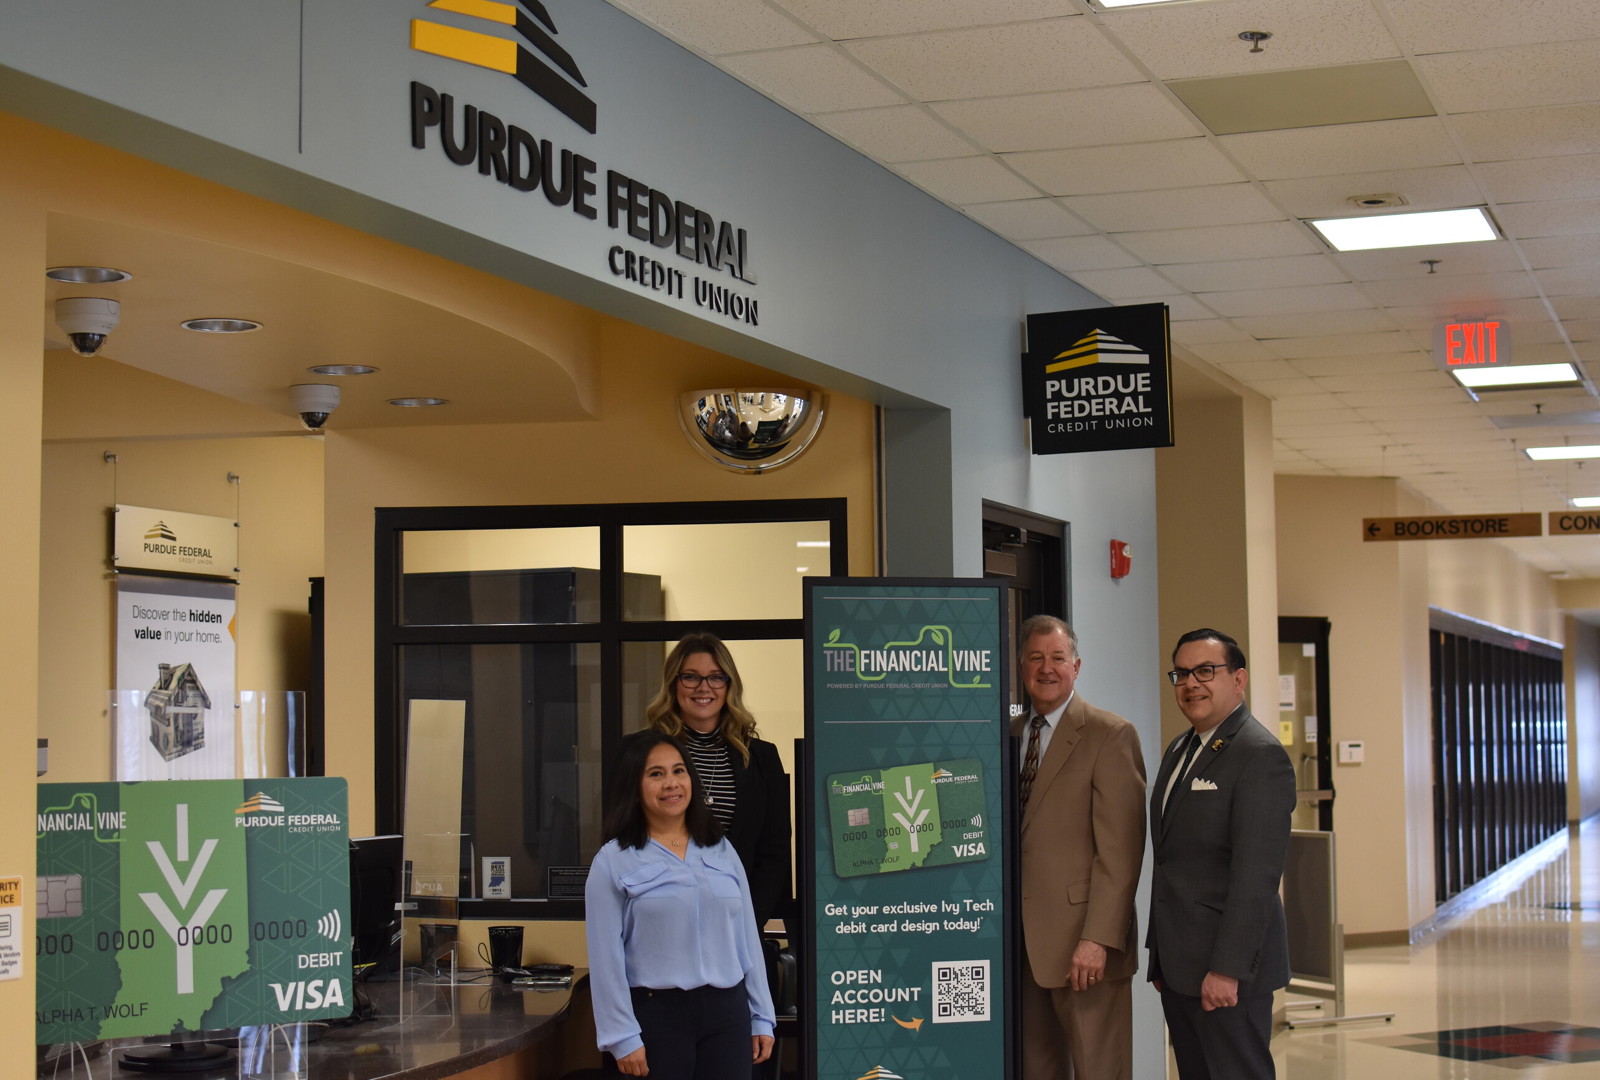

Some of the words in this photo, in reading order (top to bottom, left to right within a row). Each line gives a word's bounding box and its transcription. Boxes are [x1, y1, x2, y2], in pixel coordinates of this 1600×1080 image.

[410, 81, 597, 220] PURDUE
[607, 169, 757, 285] FEDERAL
[608, 245, 688, 299] CREDIT
[694, 276, 759, 326] UNION
[1446, 321, 1500, 365] EXIT
[1045, 373, 1151, 399] PURDUE
[1046, 395, 1152, 419] FEDERAL
[1047, 420, 1098, 433] CREDIT
[1105, 416, 1153, 429] UNION
[1394, 518, 1509, 536] BOOKSTORE
[1559, 515, 1600, 531] CON
[144, 543, 177, 555] PURDUE
[179, 546, 212, 558] FEDERAL
[132, 604, 171, 621] Discover
[172, 608, 187, 622] the
[189, 609, 222, 624] hidden
[134, 626, 162, 640] value
[164, 627, 172, 640] in
[174, 631, 194, 644] your
[196, 629, 222, 644] home.
[823, 650, 855, 672] THE
[860, 650, 948, 672] FINANCIAL
[952, 650, 991, 672] VINE
[843, 784, 872, 793] FINANCIAL
[872, 781, 885, 790] VINE
[37, 812, 94, 832] NANCIAL
[97, 811, 127, 830] VINE
[235, 815, 285, 828] PURDUE
[288, 813, 341, 826] FEDERAL
[288, 825, 314, 833] CREDIT
[843, 831, 868, 842] 0000
[876, 827, 901, 838] 0000
[909, 822, 934, 834] 0000
[942, 819, 967, 829] 0000
[963, 831, 984, 840] DEBIT
[951, 842, 986, 858] VISA
[824, 903, 848, 916] Get
[851, 905, 879, 918] your
[882, 901, 938, 914] exclusive
[941, 900, 960, 915] Ivy
[963, 899, 994, 912] Tech
[97, 928, 155, 951] 0000
[177, 923, 233, 947] 0000
[254, 919, 307, 941] 0000
[835, 922, 867, 934] debit
[870, 920, 898, 933] card
[900, 919, 940, 934] design
[298, 952, 343, 969] DEBIT
[831, 969, 882, 985] OPEN
[268, 978, 344, 1012] VISA
[831, 987, 922, 1005] ACCOUNT
[87, 1006, 99, 1021] T.
[104, 1002, 149, 1019] WOLF
[831, 1008, 886, 1025] HERE!
